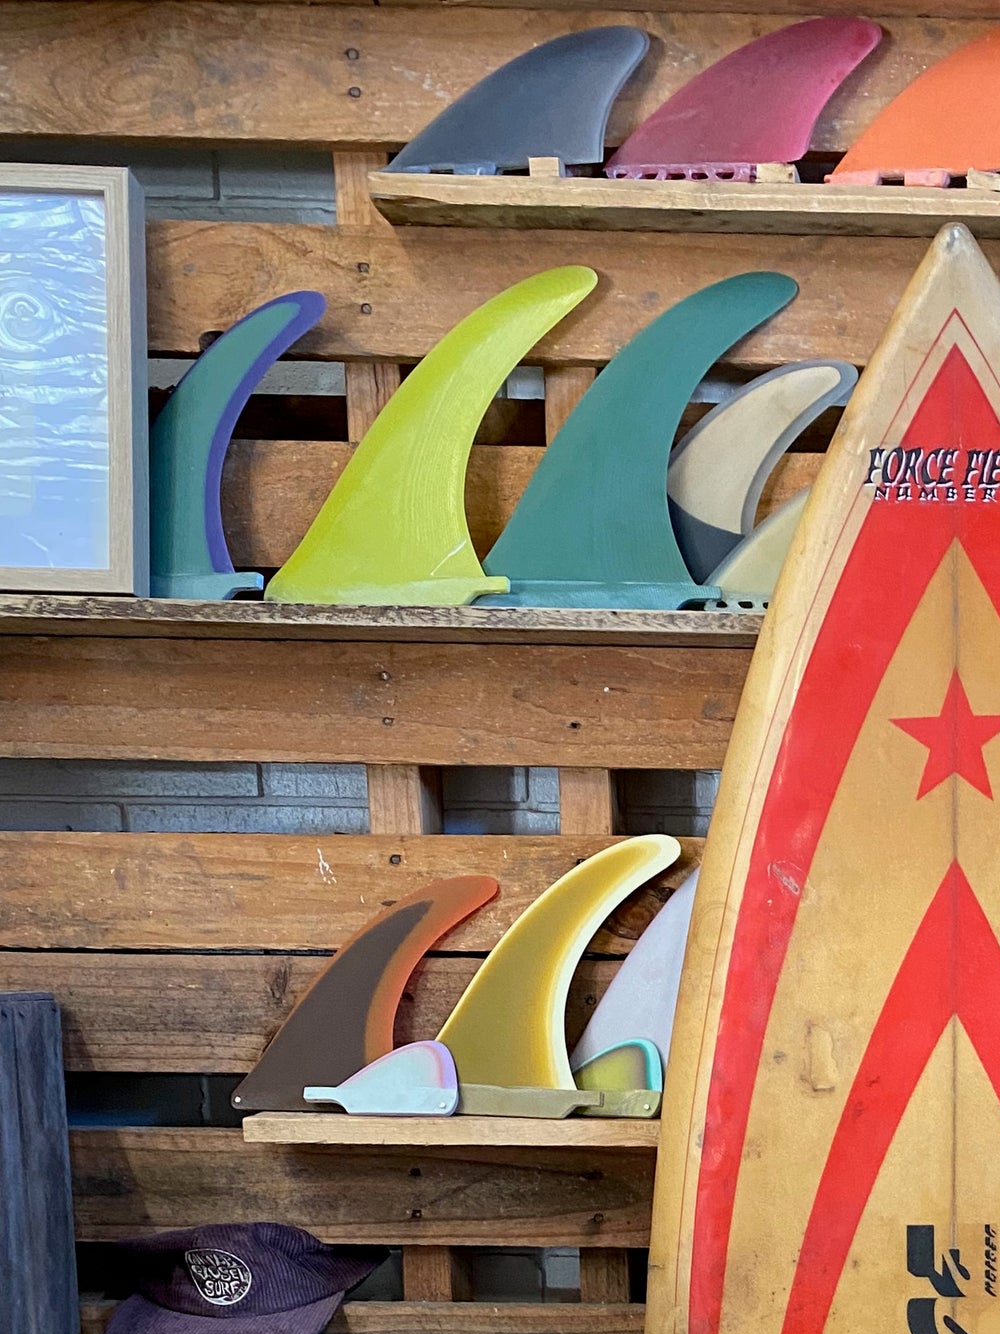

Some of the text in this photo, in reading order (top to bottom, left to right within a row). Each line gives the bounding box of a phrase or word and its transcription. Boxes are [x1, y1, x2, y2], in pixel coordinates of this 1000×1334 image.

[863, 446, 960, 488] FORCE
[873, 486, 998, 503] NUMBER
[204, 1280, 240, 1297] SURF
